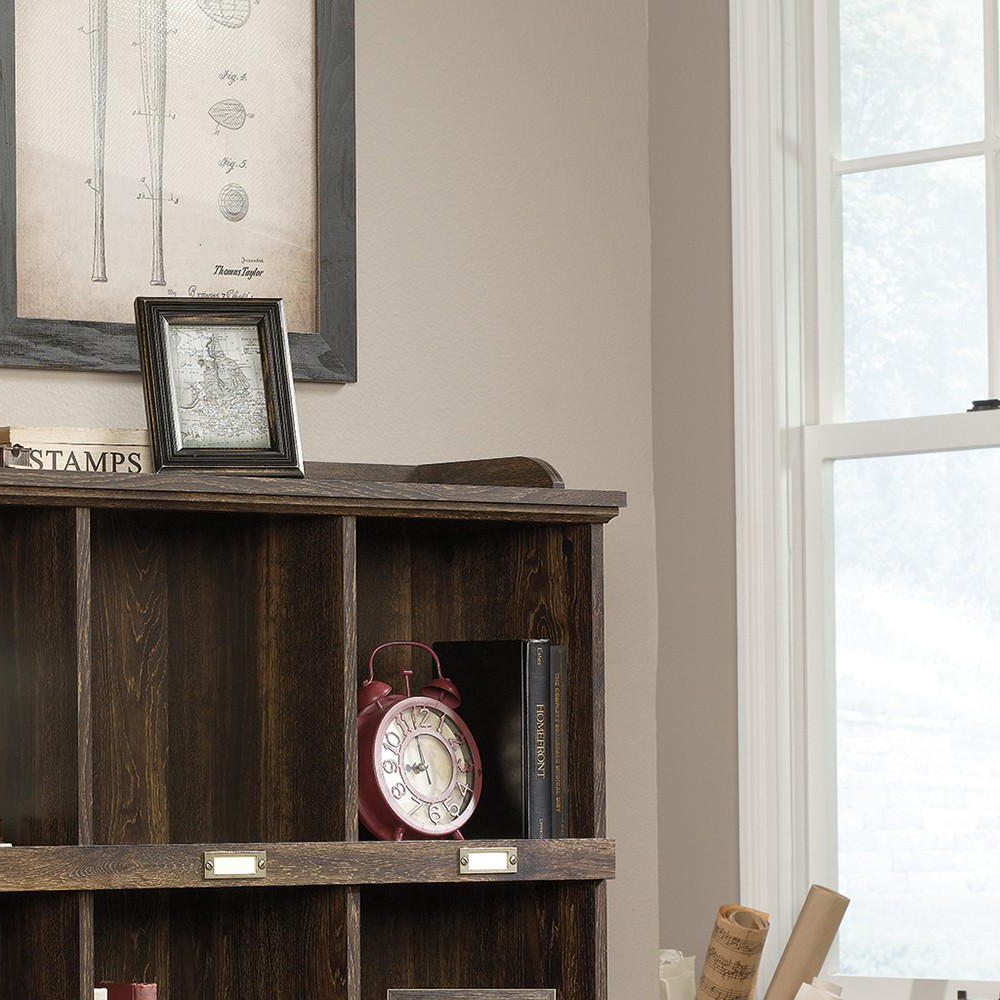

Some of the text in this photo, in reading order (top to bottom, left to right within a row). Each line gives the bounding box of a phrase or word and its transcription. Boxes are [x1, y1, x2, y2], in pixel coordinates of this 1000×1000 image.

[213, 264, 265, 280] Thomas Taylor
[30, 450, 142, 474] STAMPS
[410, 706, 433, 730] 12
[436, 713, 448, 733] 1
[383, 730, 403, 755] 10
[449, 732, 466, 752] 2
[536, 703, 546, 779] HOMEFRONT
[383, 759, 398, 775] 9
[391, 782, 407, 800] 8
[456, 781, 474, 797] 4
[407, 797, 421, 817] 7
[427, 803, 442, 825] 6
[444, 798, 461, 818] 5
